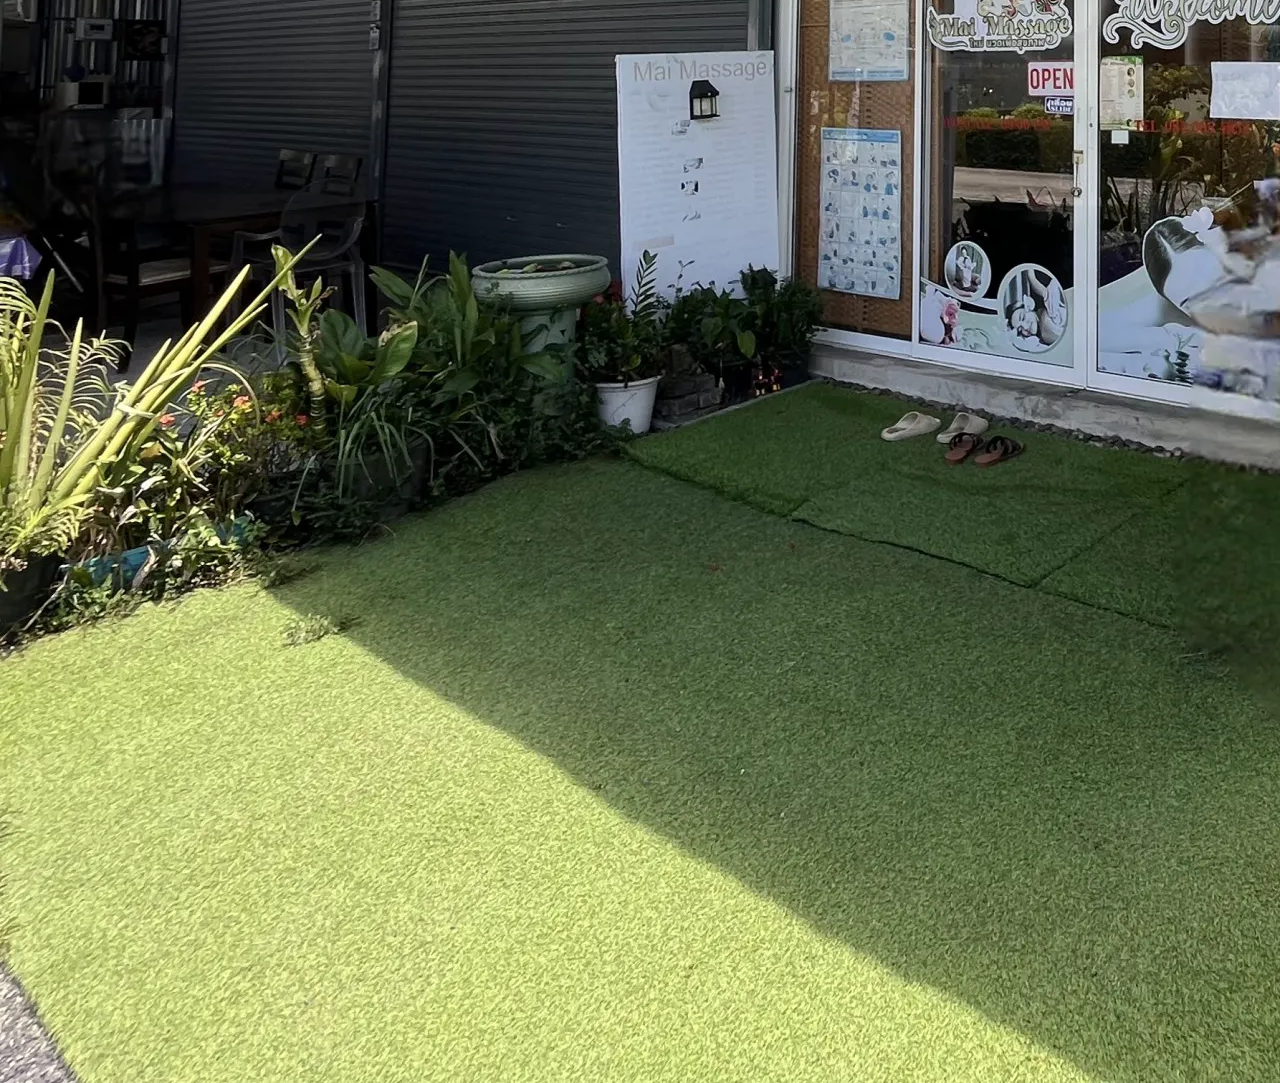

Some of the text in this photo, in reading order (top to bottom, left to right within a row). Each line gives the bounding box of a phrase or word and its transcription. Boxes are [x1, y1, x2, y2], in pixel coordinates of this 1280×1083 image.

[937, 15, 1070, 45] Mai Massage
[633, 59, 767, 82] Mai Massage
[1030, 68, 1074, 90] OPEN
